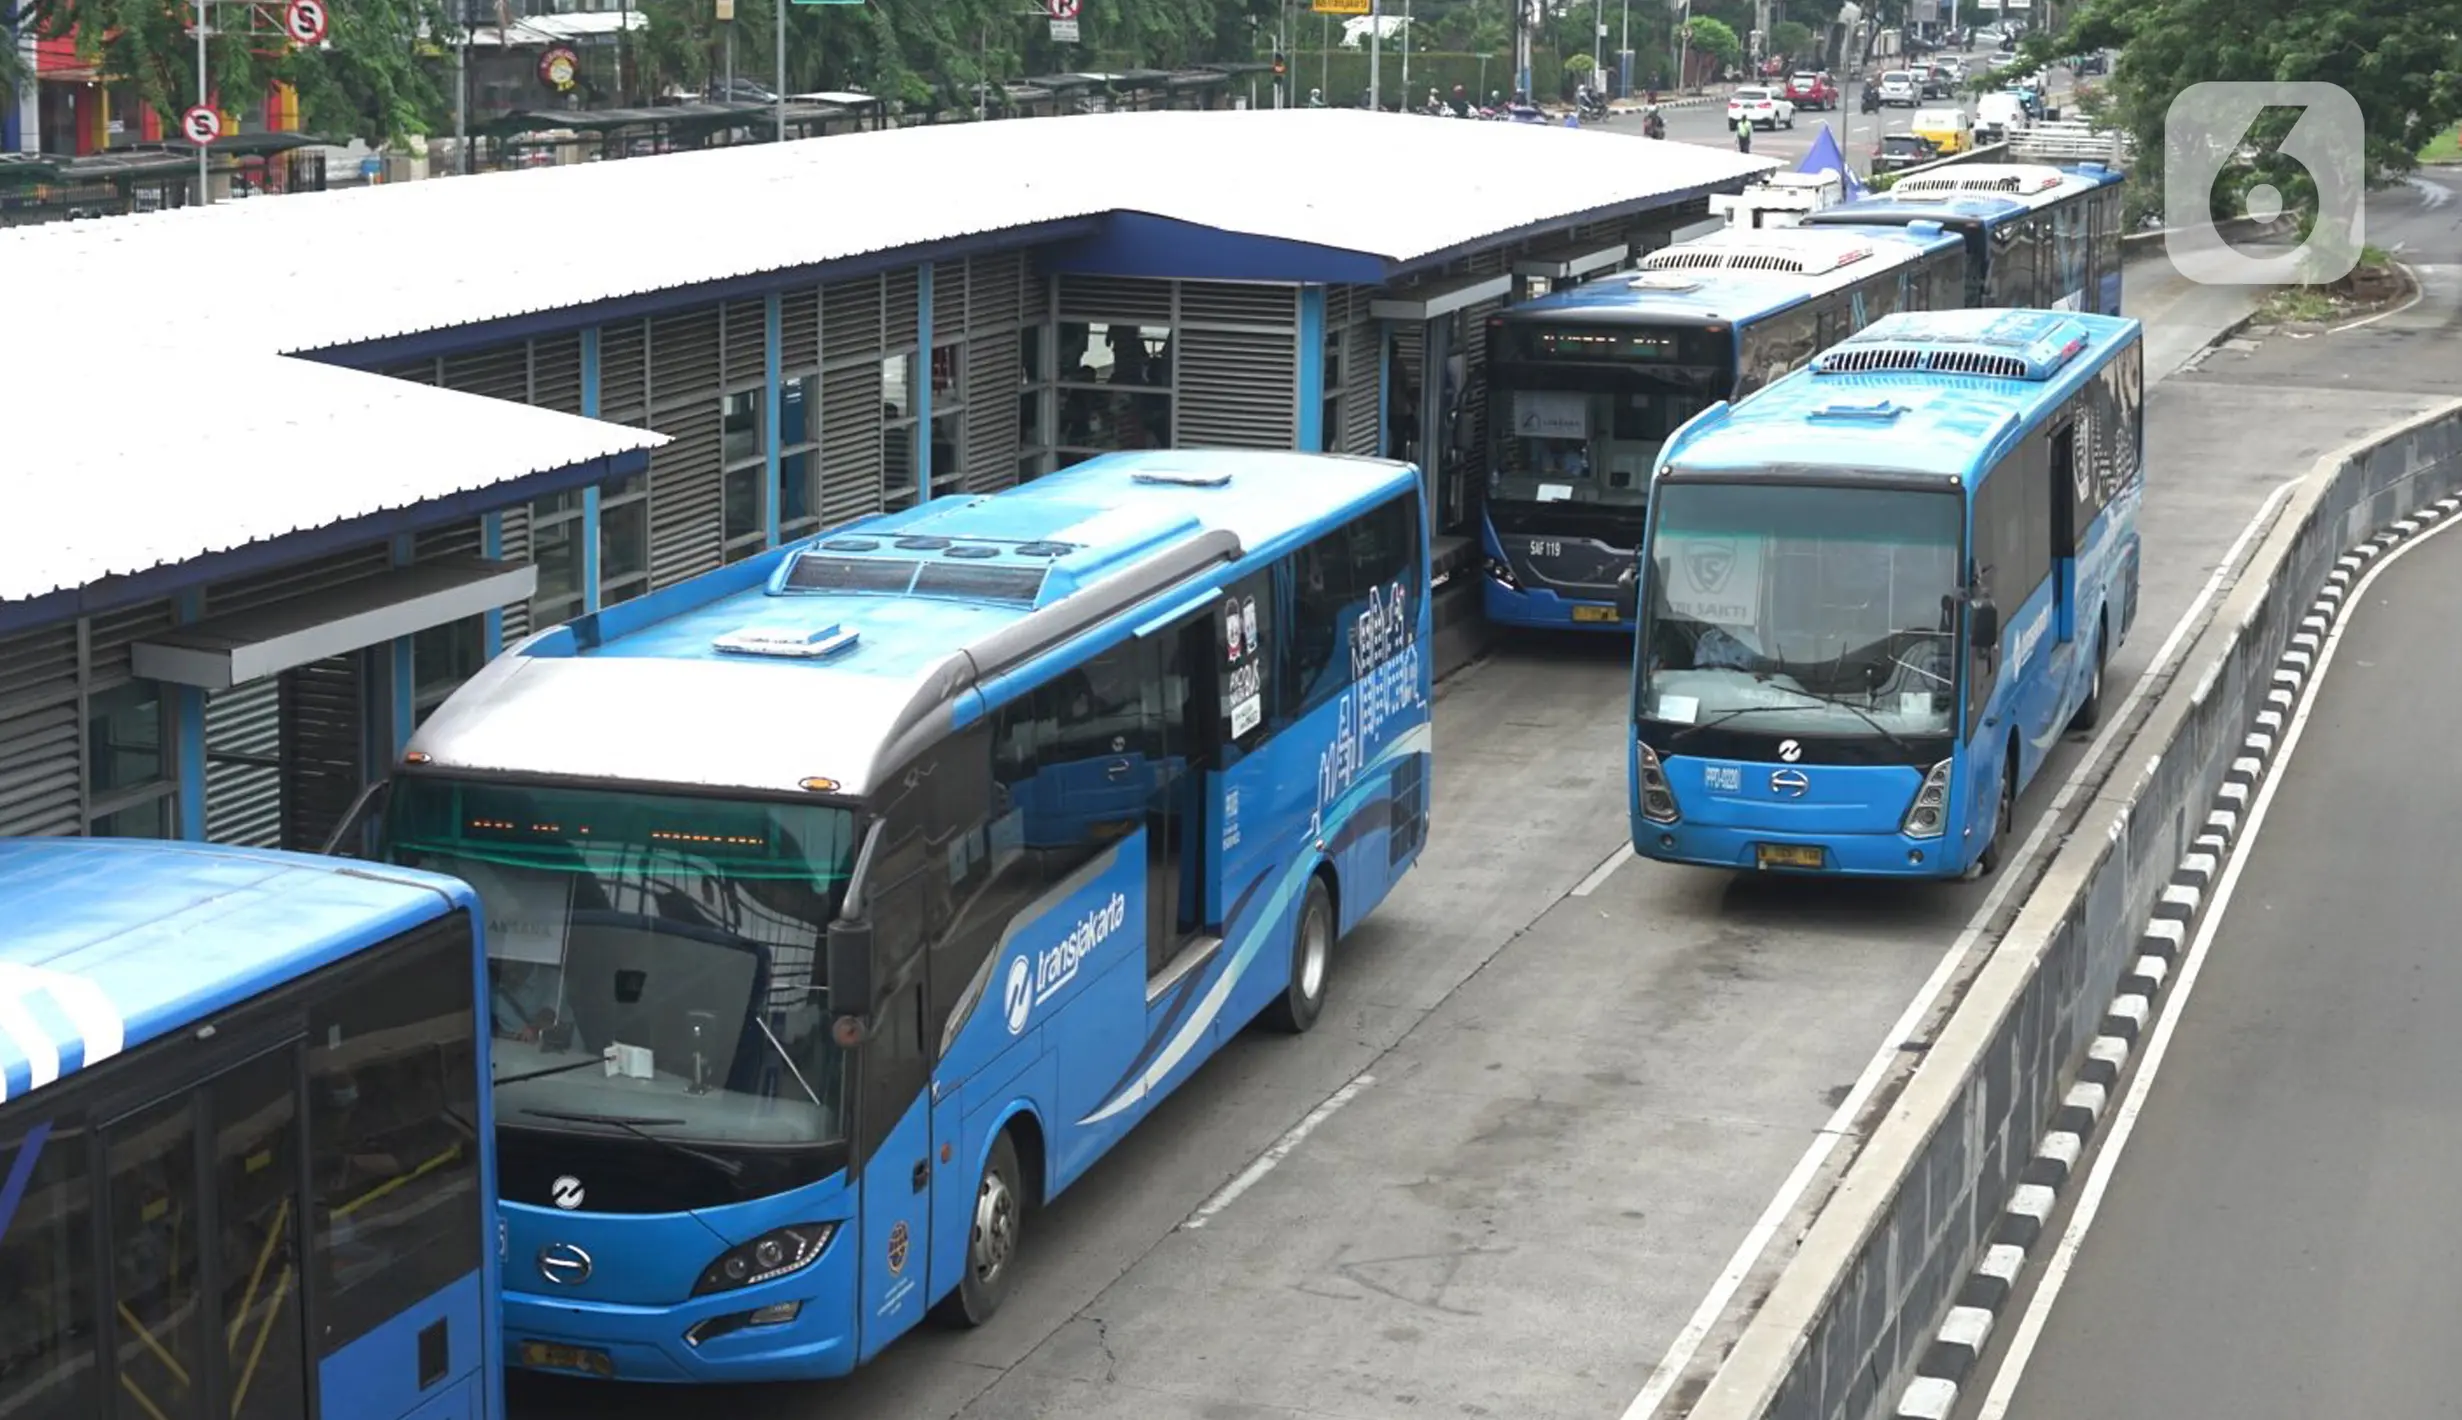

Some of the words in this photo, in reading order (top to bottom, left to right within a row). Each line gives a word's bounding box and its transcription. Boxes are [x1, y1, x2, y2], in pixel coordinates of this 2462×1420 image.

[1530, 540, 1544, 556] SAF
[1546, 541, 1561, 557] 119
[1035, 892, 1125, 1006] transjakarta
